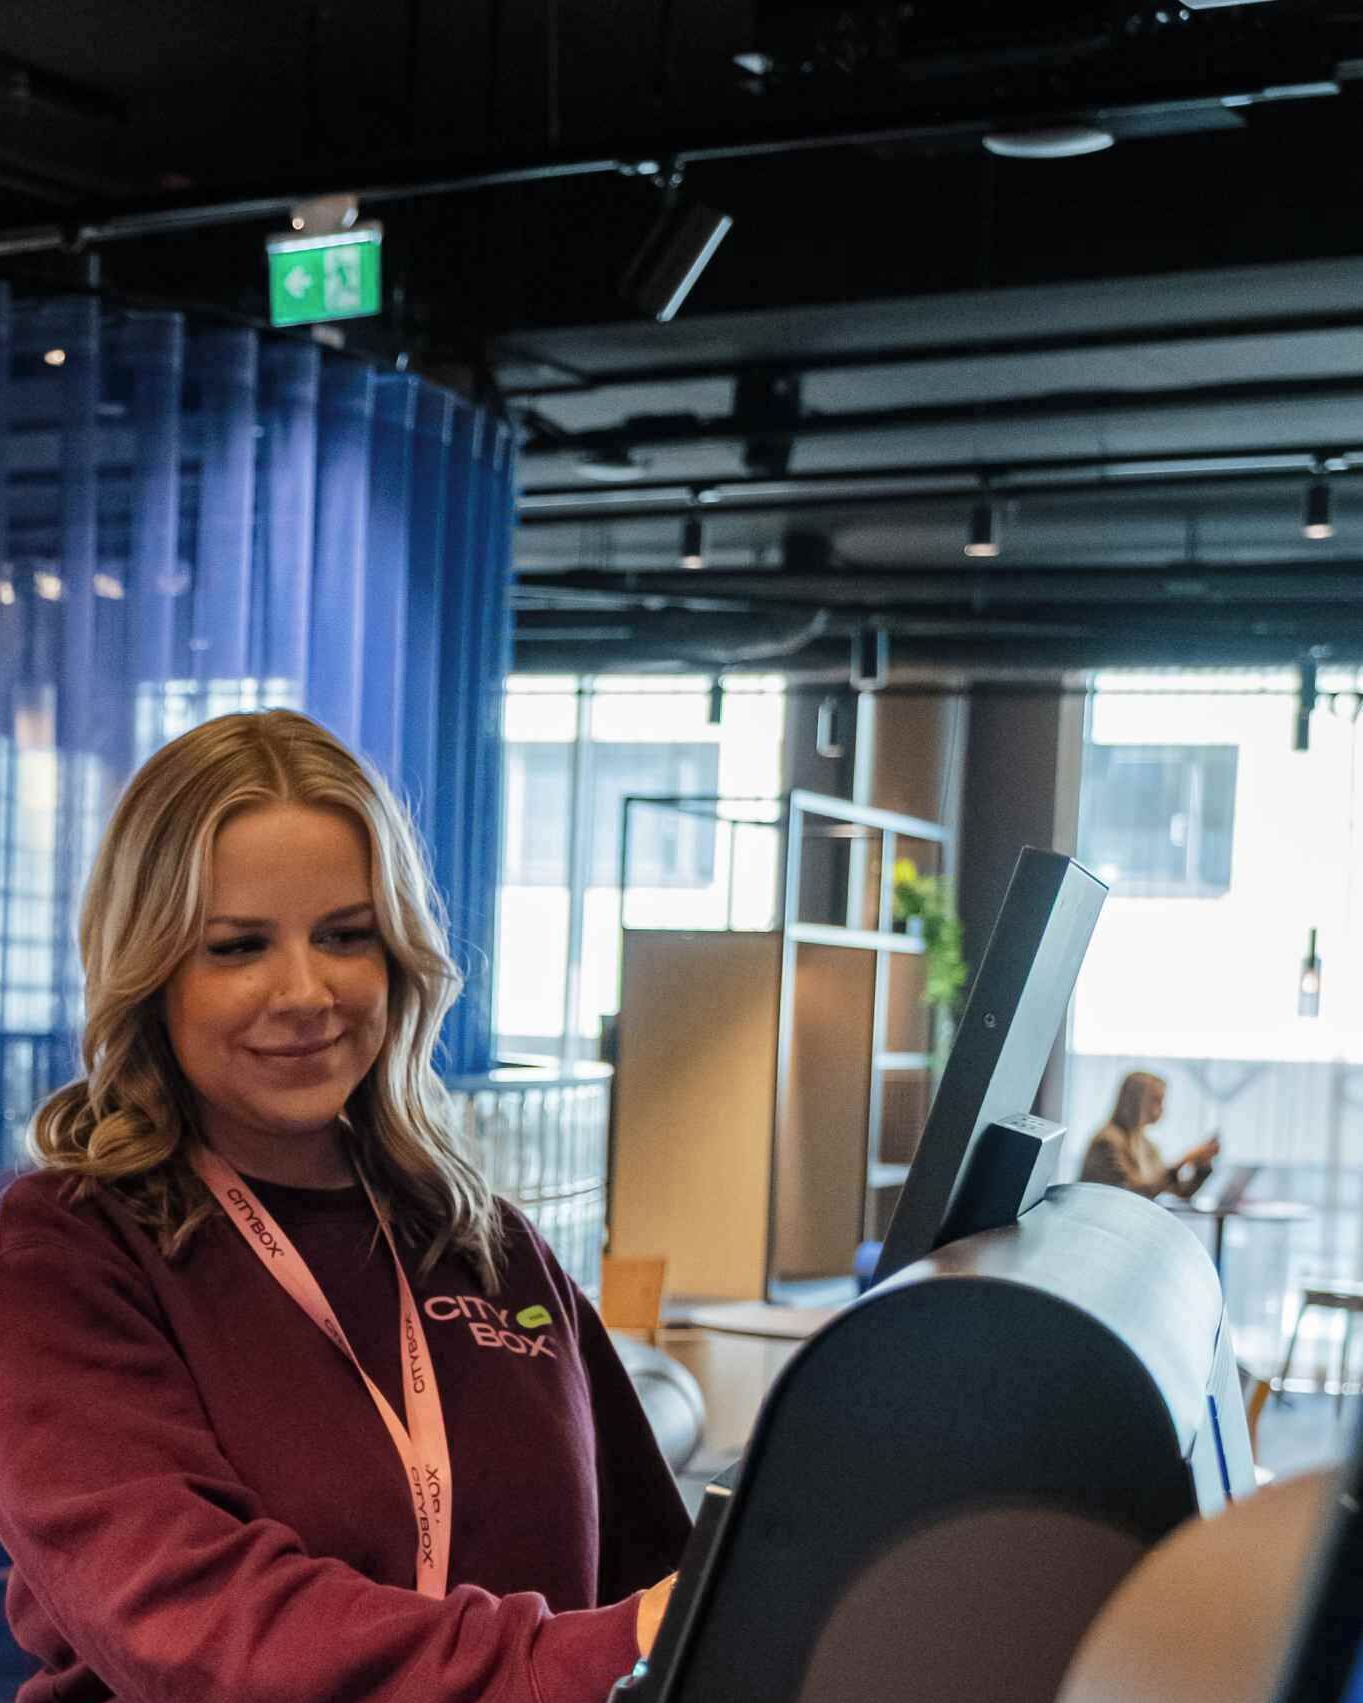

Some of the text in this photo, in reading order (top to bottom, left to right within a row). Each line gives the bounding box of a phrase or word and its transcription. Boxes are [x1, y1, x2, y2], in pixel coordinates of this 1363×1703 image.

[226, 1188, 284, 1258] CITYBOX
[424, 1295, 509, 1329] CITY
[405, 1312, 425, 1394] CITYBOX
[468, 1322, 557, 1359] BOX
